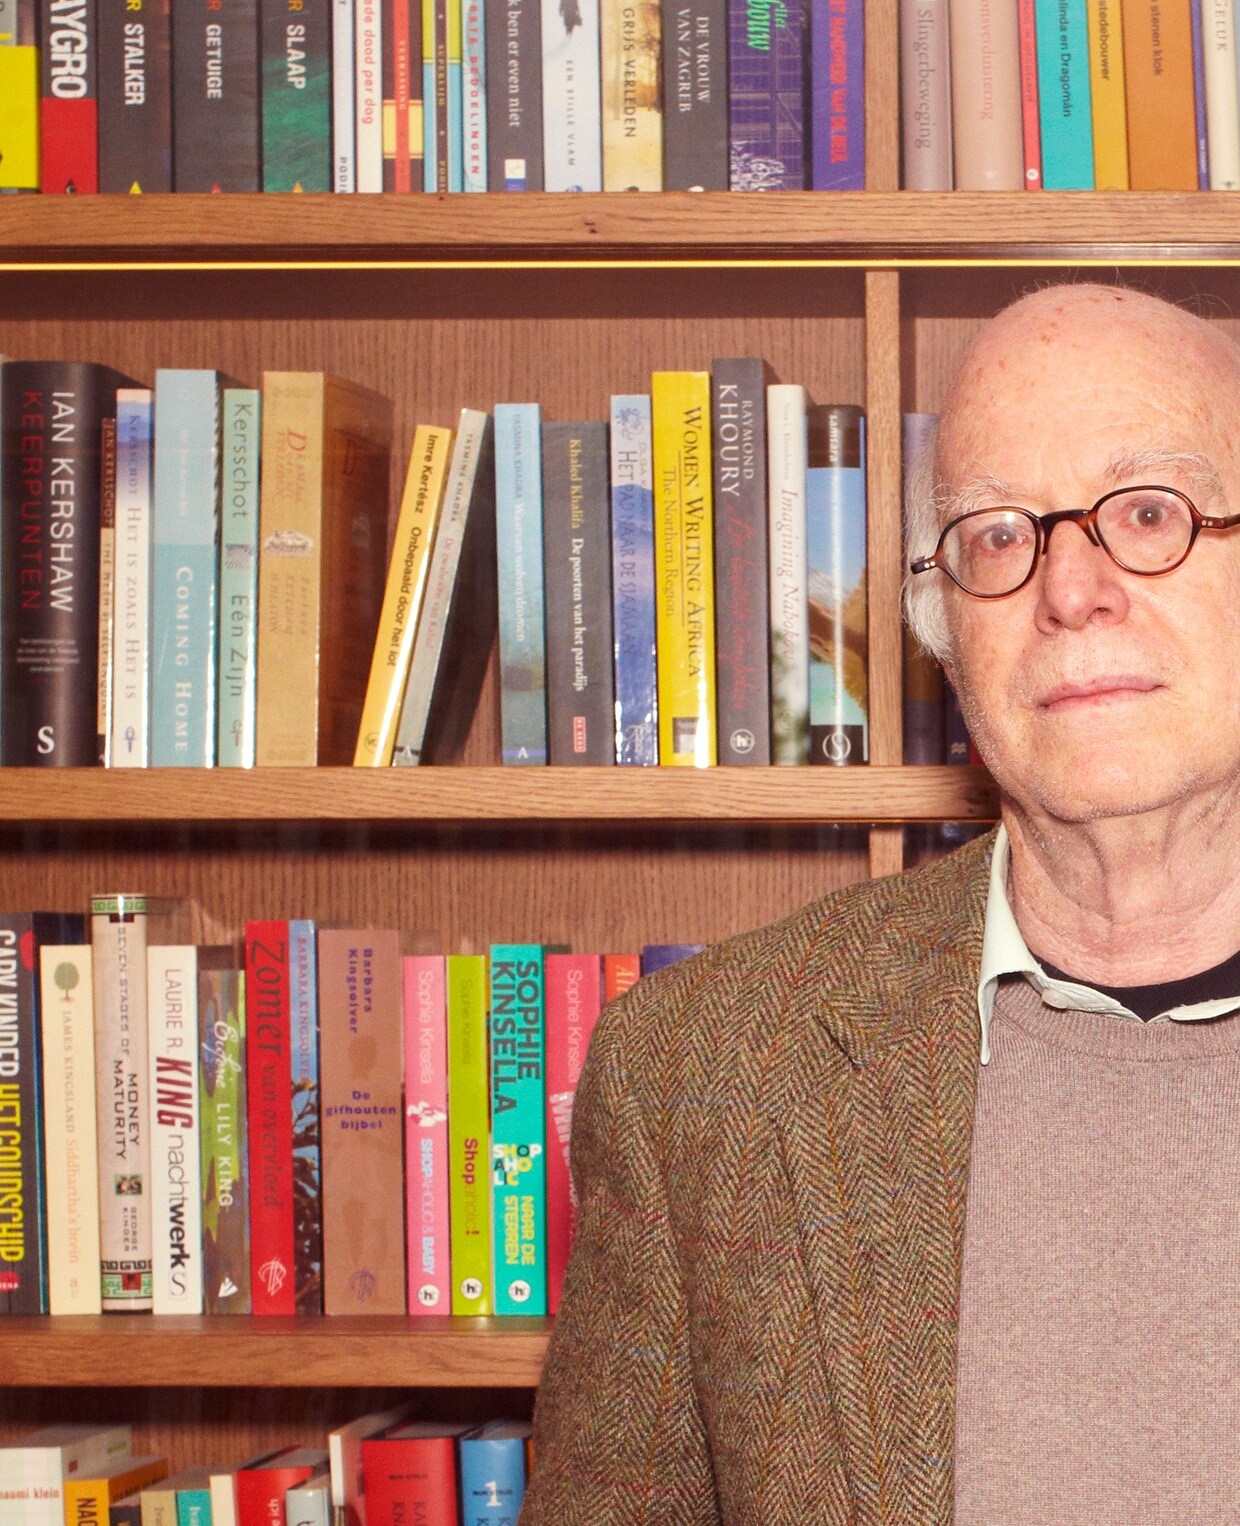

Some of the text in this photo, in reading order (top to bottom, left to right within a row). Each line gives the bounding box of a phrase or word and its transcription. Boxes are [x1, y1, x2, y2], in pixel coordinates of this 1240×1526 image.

[125, 24, 145, 105] STALKER
[206, 24, 222, 99] GETUIGE
[286, 25, 306, 89] SLAAP
[623, 8, 637, 138] GRIJS VERLEDEN
[677, 8, 692, 112] VAN ZAGREB
[696, 16, 710, 103] DE VROUW
[916, 9, 939, 149] Slingerbeweging
[232, 403, 252, 519] Kersschot
[718, 383, 741, 497] KHOURY
[742, 400, 755, 480] RAYMOND
[19, 391, 44, 609] KEERPUNTEN
[50, 392, 75, 612] IAN KERSHAW
[683, 406, 708, 678] WOMEN WRITING AFRICA
[568, 439, 587, 692] Khaled Khalifa De poorten van het paradijs
[174, 566, 193, 752] COMING HOME
[226, 594, 251, 698] Eén Zijn
[416, 971, 435, 1084] Sophie Kinsella
[493, 961, 518, 1115] KINSELLA
[517, 960, 542, 1080] SOPHIE
[114, 1059, 127, 1161] MATURITY
[128, 1072, 141, 1147] MONEY
[156, 968, 193, 1269] LAURIE R. KING nachtwerk
[217, 1103, 233, 1208] LILY KING
[504, 1194, 519, 1265] STERREN
[520, 1195, 536, 1265] NAAR DE
